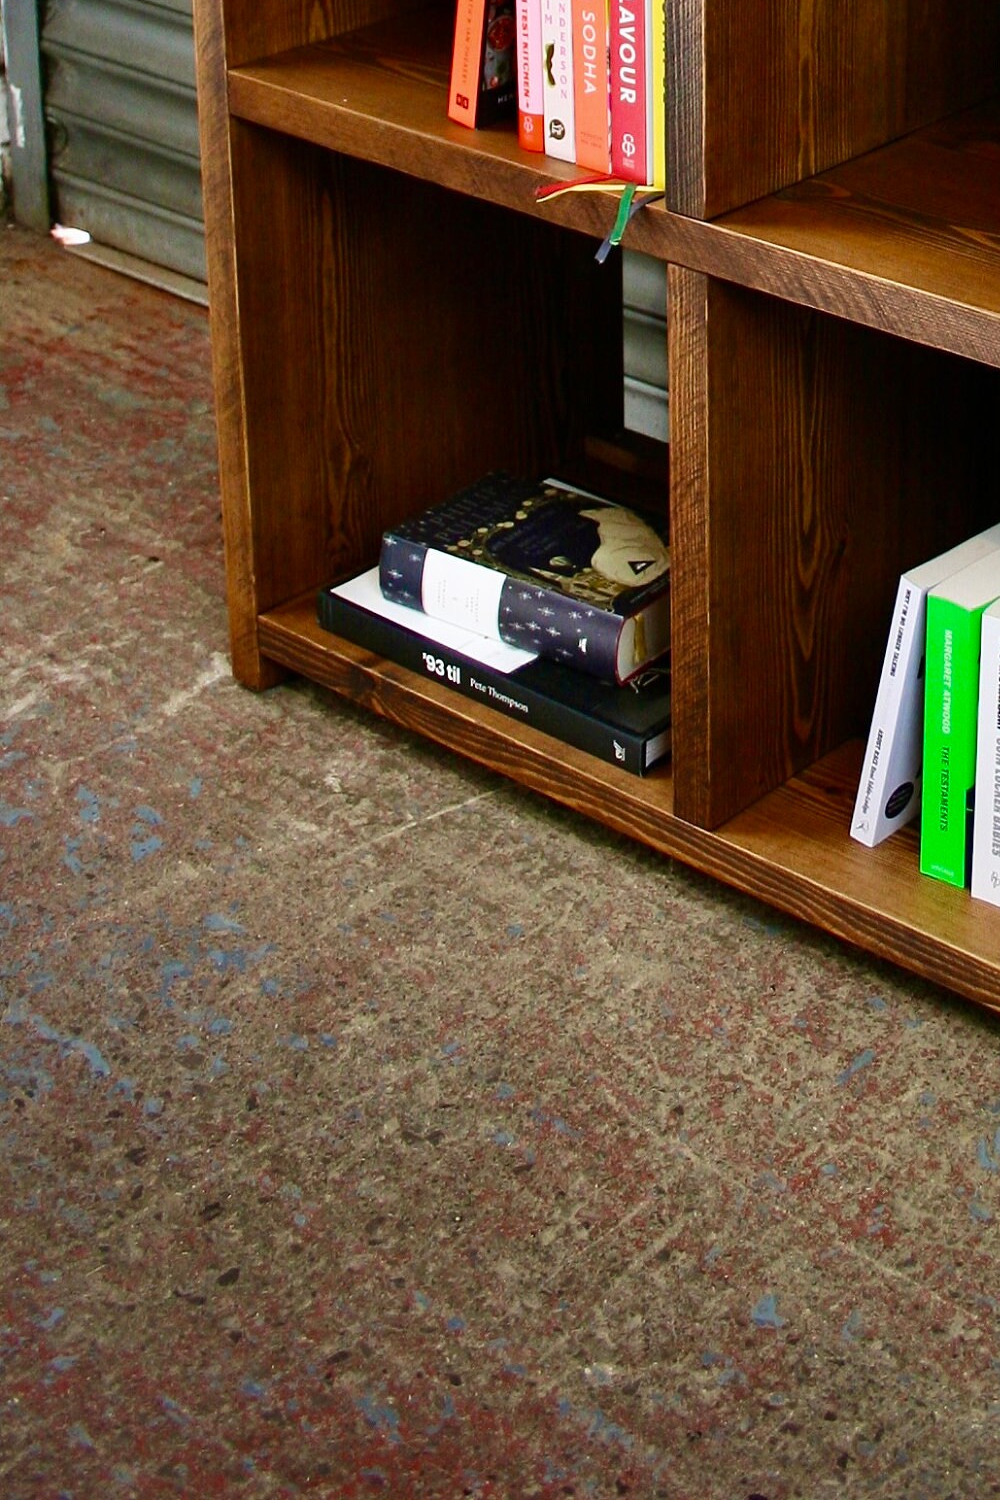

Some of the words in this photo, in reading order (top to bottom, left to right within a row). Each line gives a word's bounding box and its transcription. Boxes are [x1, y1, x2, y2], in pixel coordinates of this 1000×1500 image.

[521, 8, 530, 38] TEST
[521, 41, 531, 98] KITCHEN
[581, 10, 598, 95] SODHA
[943, 629, 953, 689] MARGARET
[446, 663, 461, 685] til
[469, 677, 487, 693] Pete
[487, 684, 529, 714] Thompson
[942, 689, 952, 735] ATWOOD
[940, 746, 950, 766] THE
[940, 766, 950, 833] TESTAMENTS
